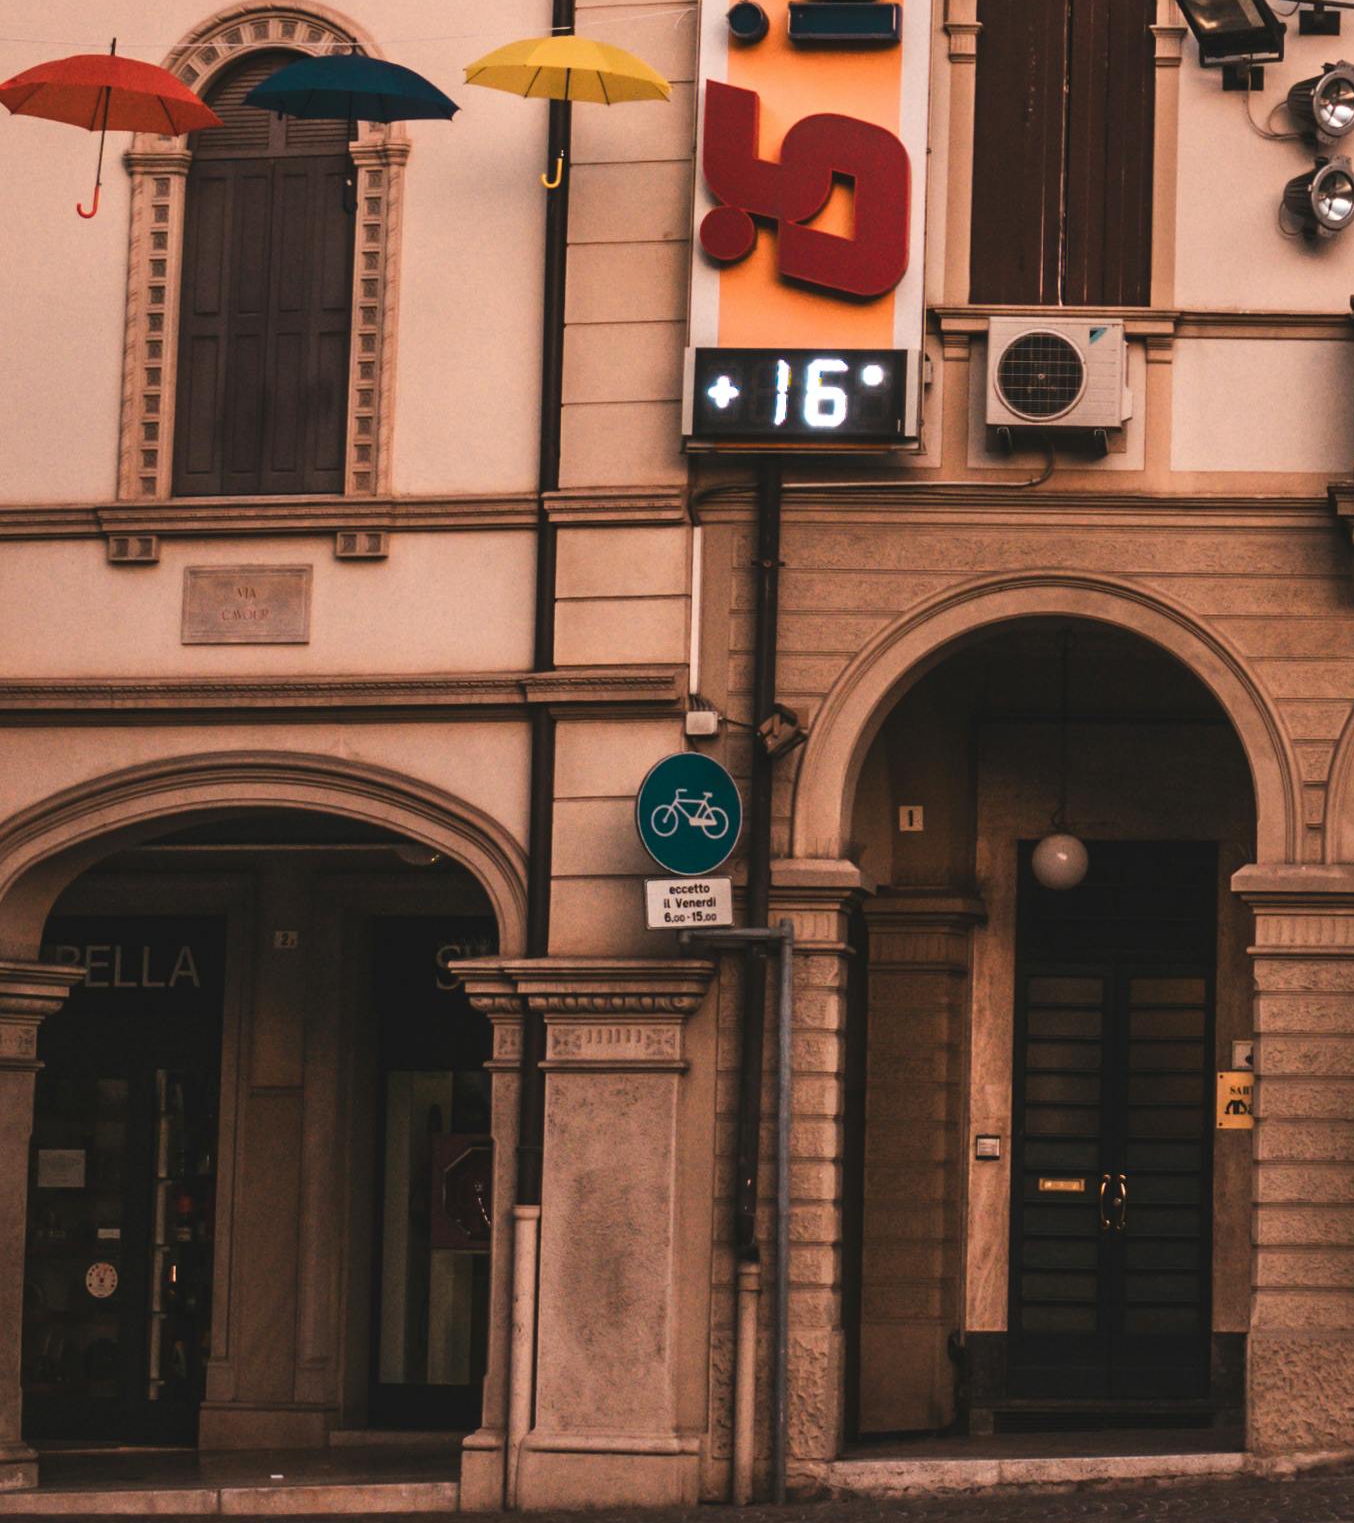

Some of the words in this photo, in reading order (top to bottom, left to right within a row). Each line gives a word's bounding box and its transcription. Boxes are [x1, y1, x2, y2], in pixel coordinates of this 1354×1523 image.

[237, 586, 257, 599] VIA
[669, 883, 711, 895] eccetto
[663, 898, 671, 909] il
